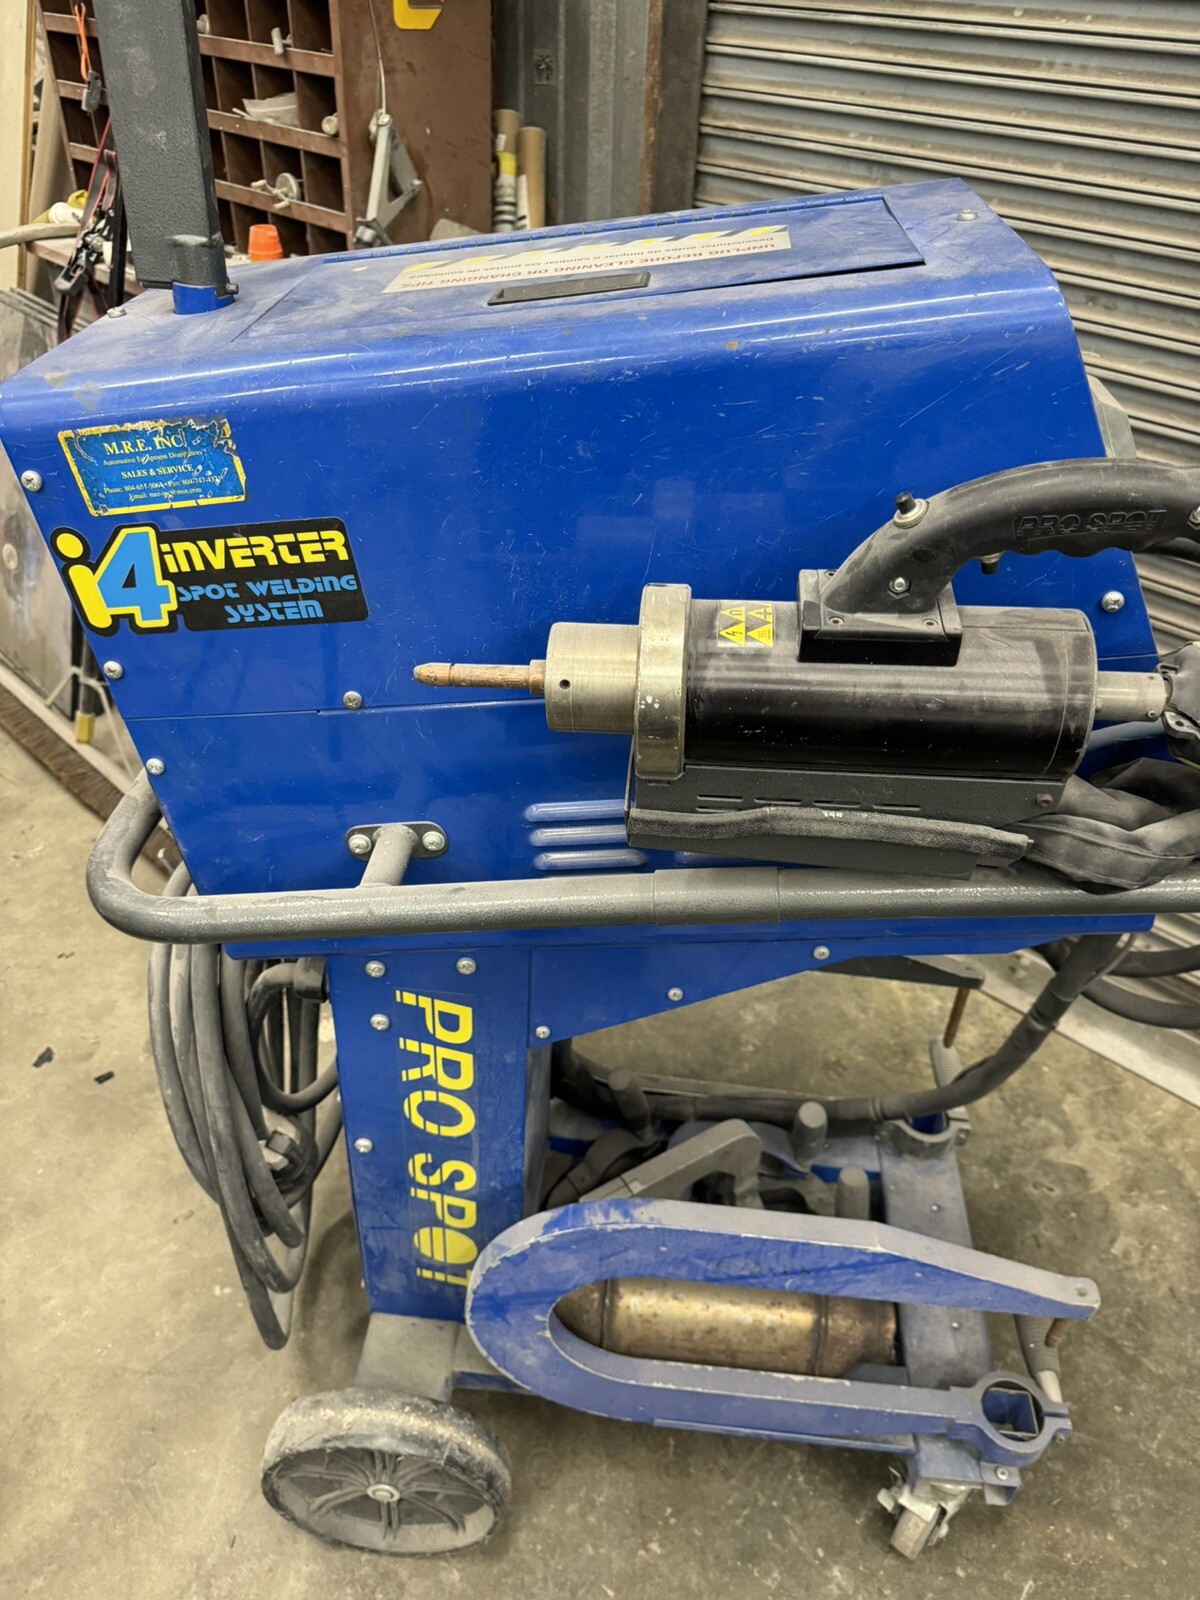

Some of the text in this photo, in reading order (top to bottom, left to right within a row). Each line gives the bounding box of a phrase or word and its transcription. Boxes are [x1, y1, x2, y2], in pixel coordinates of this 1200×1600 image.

[400, 243, 776, 290] UNPLUG BEFORE CLEANING OR CHANGING TIPS
[103, 438, 152, 455] M.R.E.
[103, 450, 203, 466] Automotive Eqipment Distriutors
[121, 464, 193, 479] SALES & SERVICE
[1016, 509, 1167, 536] PRO SPOT
[176, 582, 240, 603] SPOT
[224, 599, 325, 624] SYSTEM
[395, 989, 479, 1288] PRO SPOT
